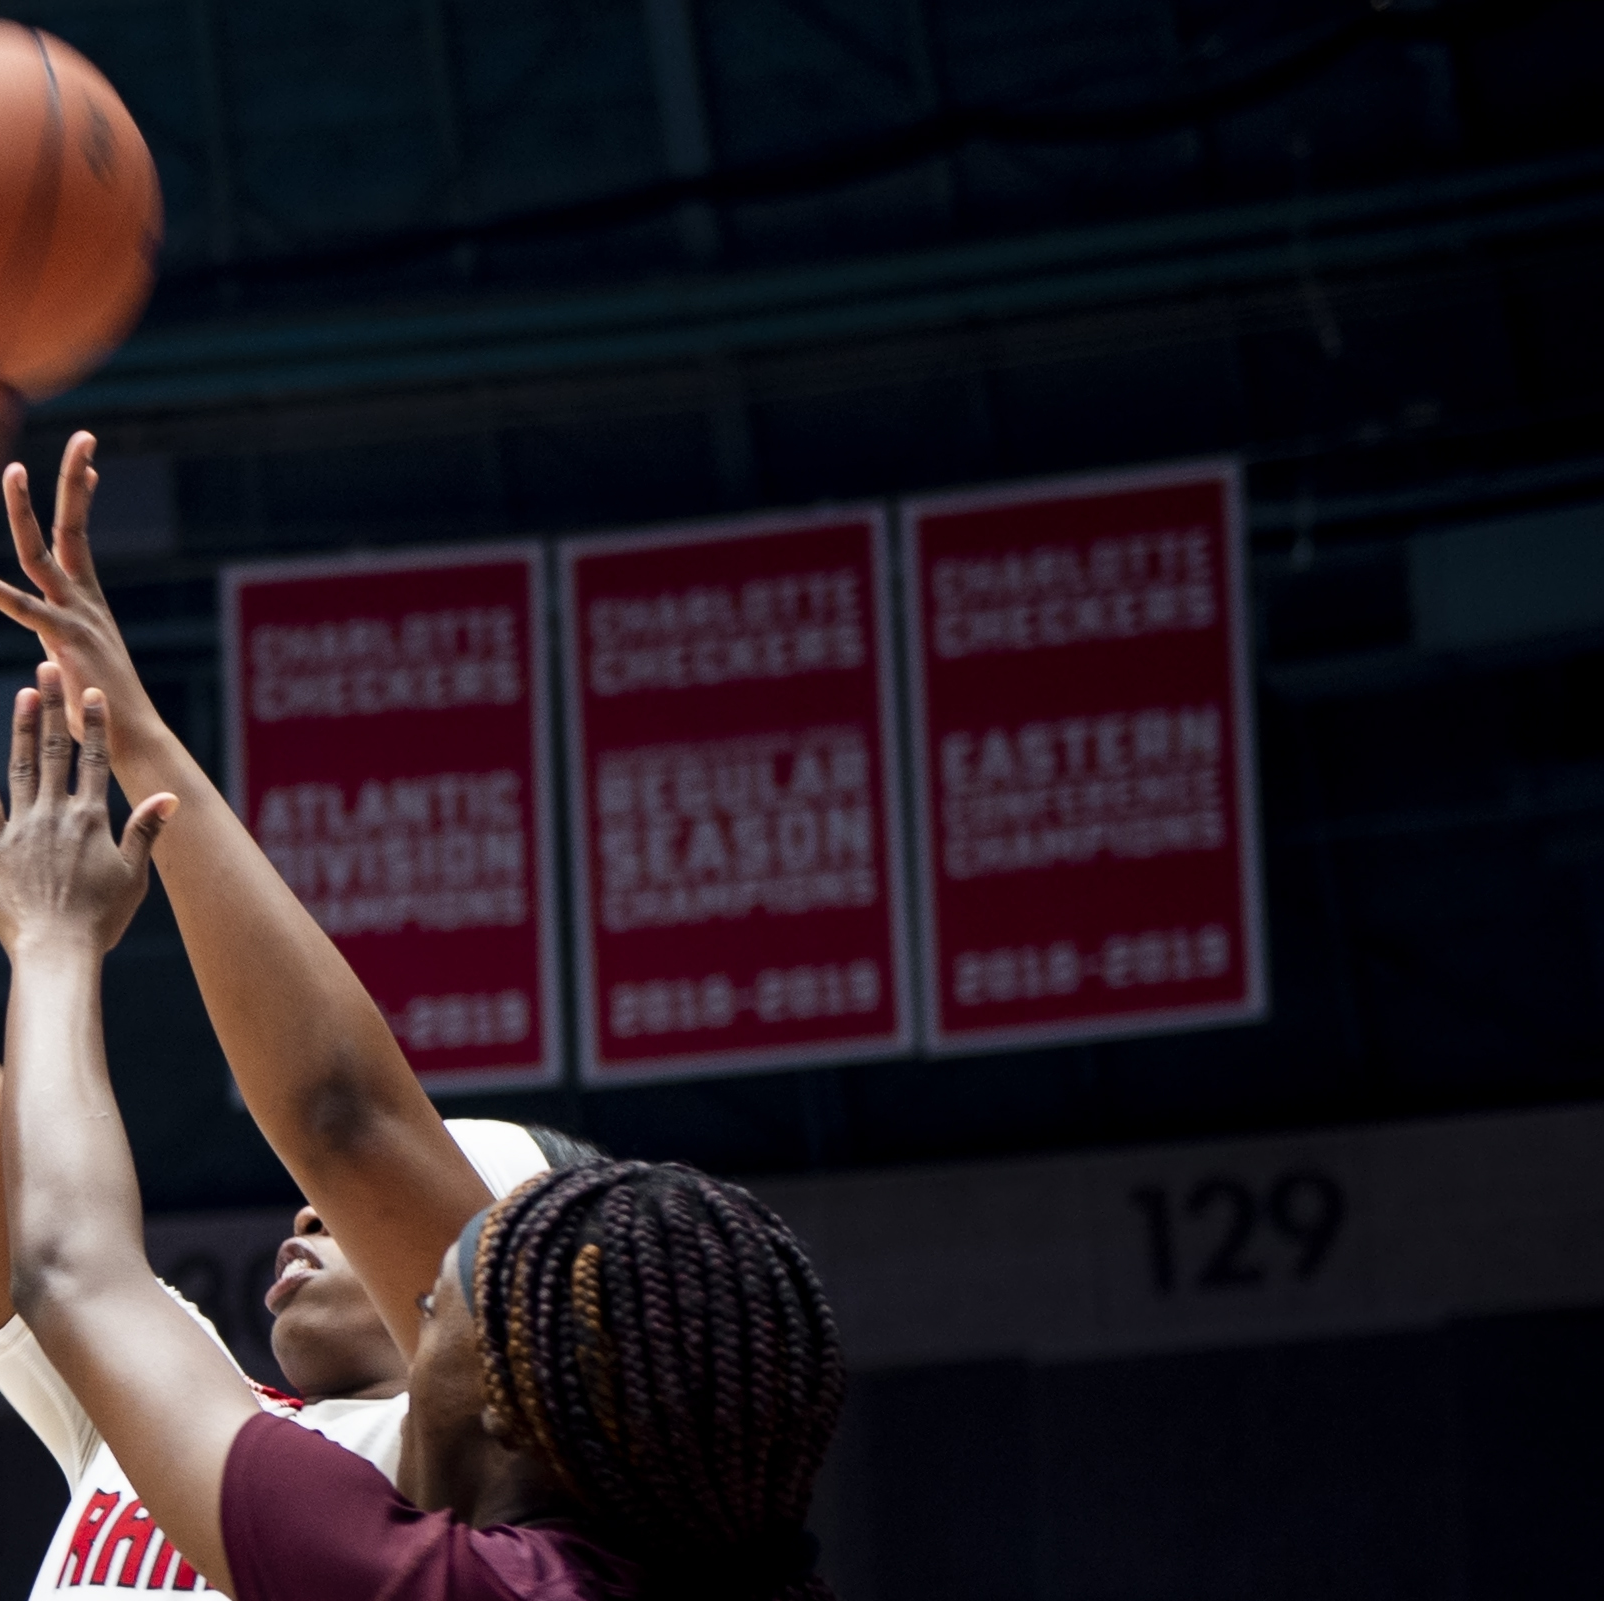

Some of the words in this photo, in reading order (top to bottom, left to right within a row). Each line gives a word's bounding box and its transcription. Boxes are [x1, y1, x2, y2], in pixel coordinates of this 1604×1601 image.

[933, 583, 1216, 661] CHECKERS
[250, 660, 521, 723] CHECKERS
[591, 623, 866, 698] CHECKERS
[599, 748, 868, 816] REGULAR
[940, 703, 1222, 796] EASTERN
[256, 767, 523, 840] ATLANTIC
[601, 805, 872, 891] SEASON
[1130, 1170, 1347, 1295] 129
